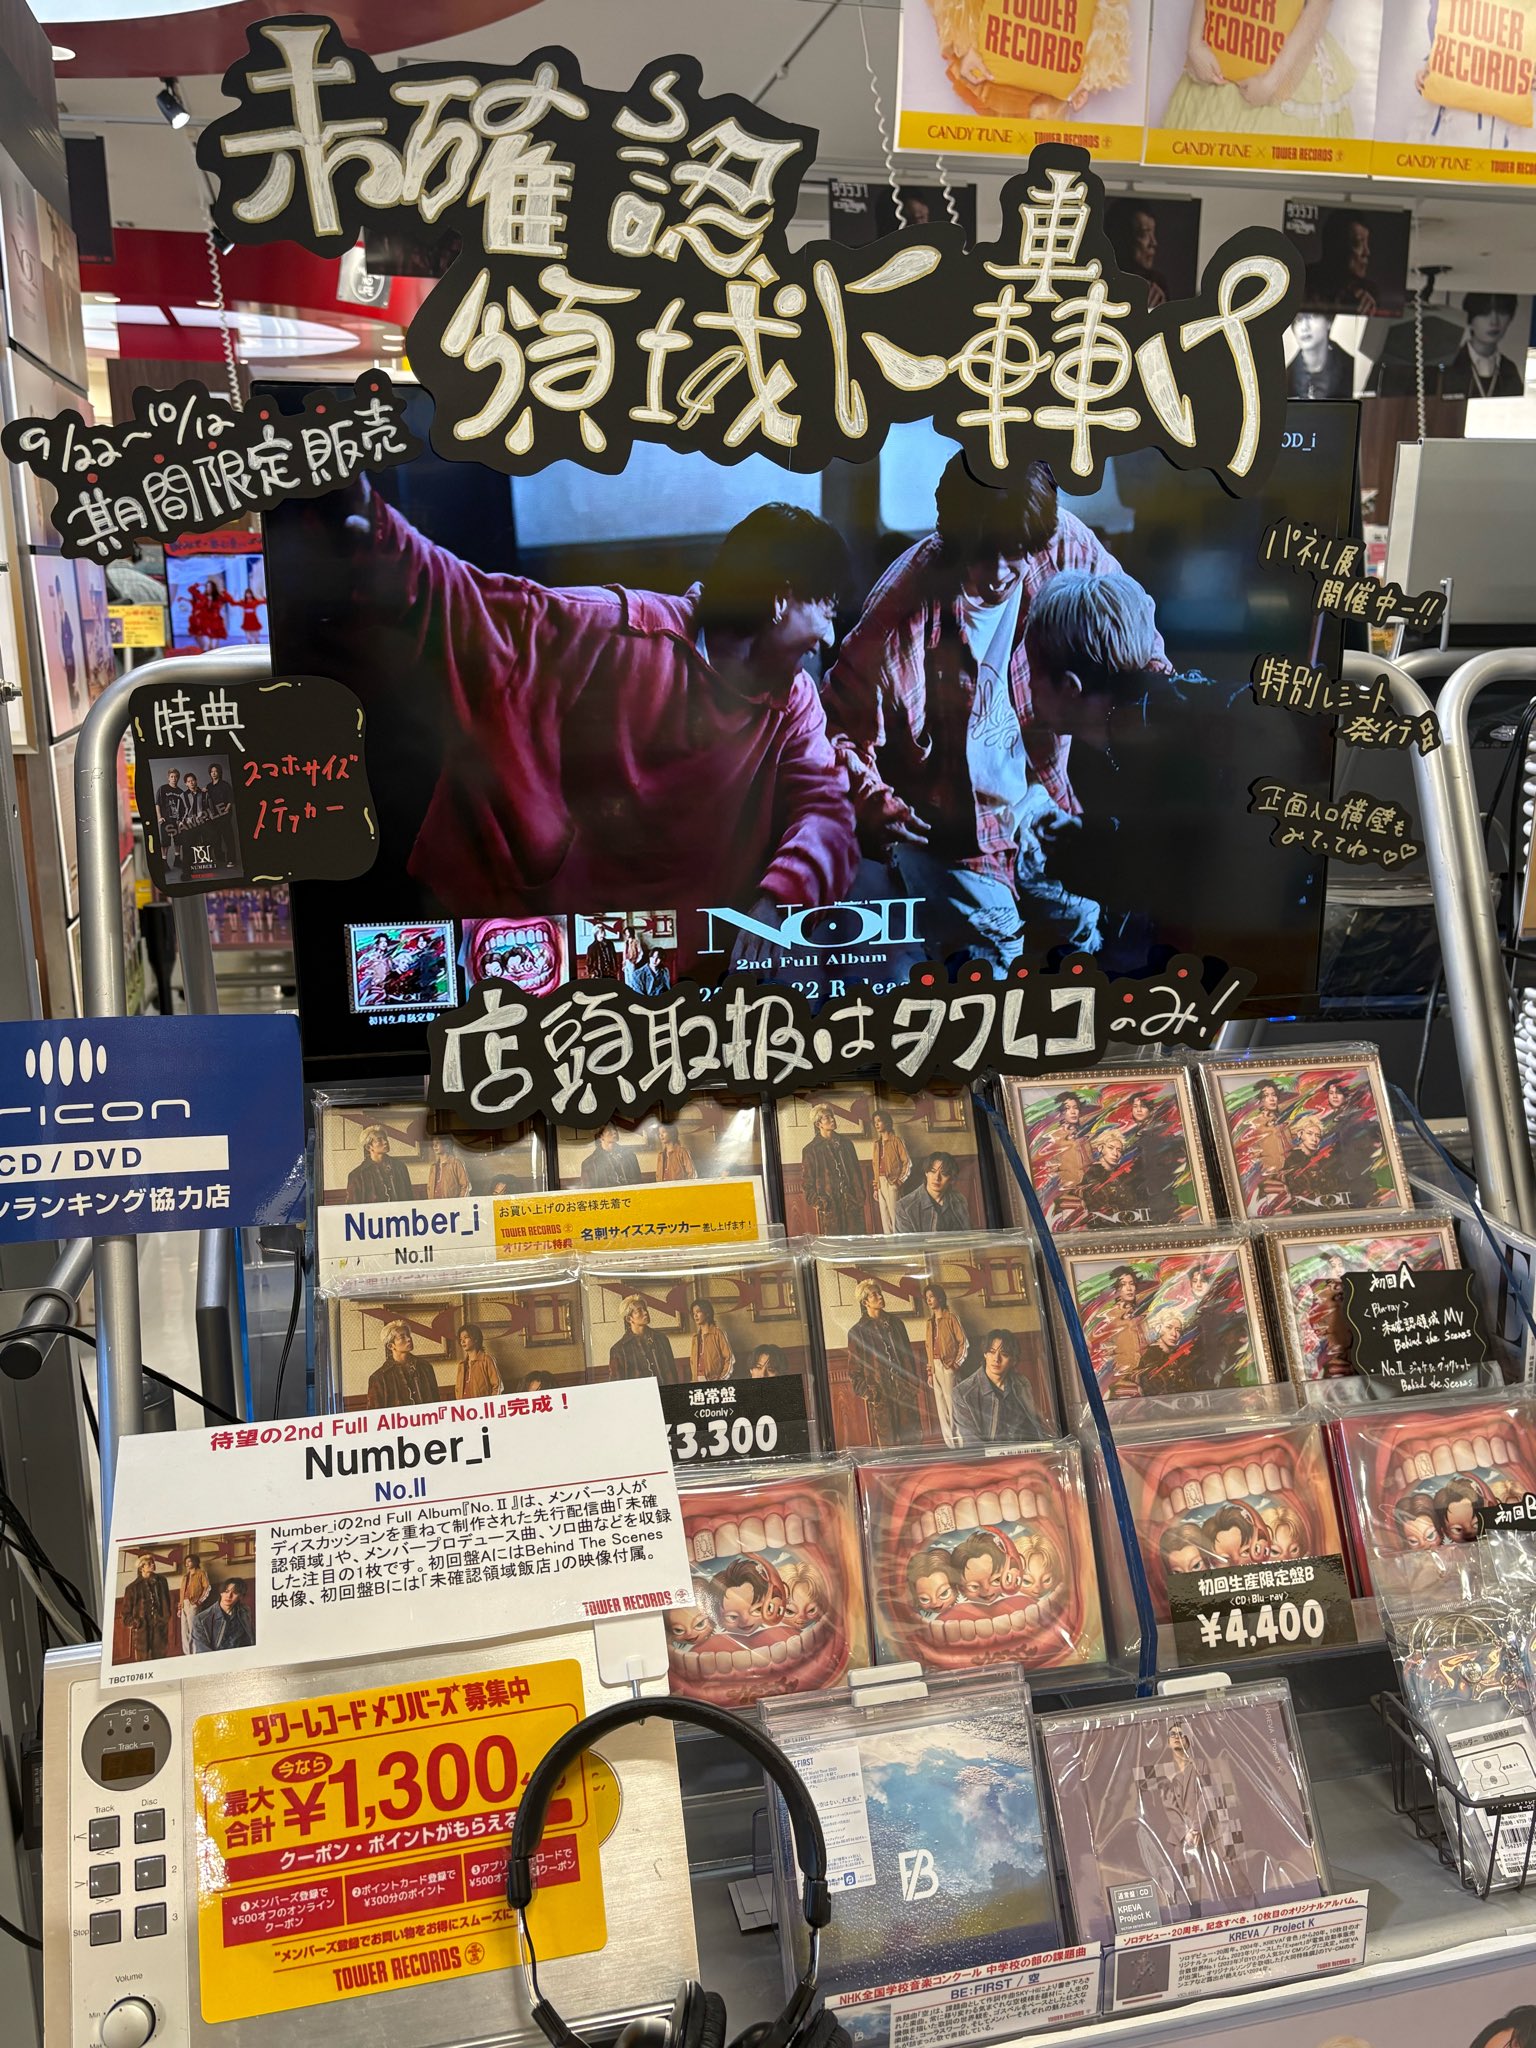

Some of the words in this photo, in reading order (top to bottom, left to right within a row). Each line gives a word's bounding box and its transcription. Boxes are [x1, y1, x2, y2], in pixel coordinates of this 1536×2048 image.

[985, 15, 1084, 74] RECORDS
[1432, 33, 1534, 96] RECORDS
[928, 125, 974, 141] CANDY
[977, 128, 1012, 143] TUNE
[220, 24, 803, 284] 未確認
[1172, 141, 1215, 157] CANDY
[1217, 144, 1251, 158] TUNE
[1272, 146, 1297, 160] TOWER
[1299, 148, 1333, 162] RECORDS
[1396, 154, 1438, 169] CANDY
[1440, 157, 1471, 171] TUNE
[1491, 159, 1515, 173] TOWER
[67, 398, 407, 556] 期間限定販売
[1266, 524, 1359, 577] パネル展
[153, 687, 245, 752] 特典
[243, 753, 358, 787] スマホサイズ
[165, 802, 229, 837] SAMPLE
[736, 957, 772, 970] 2nd
[779, 955, 818, 968] Full
[826, 953, 887, 965] Album
[344, 1204, 480, 1242] Number_i
[499, 1198, 631, 1218] お買い上げのお客様先着で
[501, 1227, 527, 1238] TOWER
[528, 1224, 562, 1236] RECORDS
[580, 1220, 701, 1241] 名刺サイズステッカー
[395, 1245, 433, 1265] No.II
[503, 1238, 573, 1253] オリジナル特典
[1444, 1307, 1463, 1327] MV
[1425, 1334, 1440, 1345] the
[689, 1386, 737, 1406] 通常盤
[210, 1425, 323, 1451] 待望の2nd
[332, 1416, 368, 1437] Full
[305, 1426, 491, 1480] Number_i
[375, 1477, 426, 1502] No.II
[271, 1514, 381, 1539] Number_iの2nd
[387, 1510, 412, 1525] Full
[271, 1494, 658, 1556] ディスカッションを重ねて制作された先行配信曲「未確
[271, 1508, 672, 1574] 認領域」や、メンバープロデュース曲、ソロ曲などを収録
[272, 1537, 574, 1591] した注目の1枚です。初回盤AにはBehind
[580, 1536, 606, 1549] The
[612, 1529, 663, 1545] Scenes
[271, 1545, 655, 1610] 映像、初回盤Bには「未確認領域飯店」の映像付属。
[1198, 1566, 1315, 1596] 初回生産限定盤B
[582, 1597, 621, 1616] TOWER
[624, 1590, 672, 1611] RECORDS
[1196, 1599, 1325, 1649] ¥4,400
[109, 1671, 154, 1685] TBCT0761X
[109, 1719, 113, 1727] 1
[126, 1717, 131, 1726] 2
[144, 1715, 149, 1723] 3
[121, 1707, 136, 1717] Disc
[118, 1741, 139, 1751] Track
[277, 1756, 326, 1777] 今なら
[282, 1734, 517, 1837] ¥1,300
[94, 1804, 115, 1814] Track
[141, 1798, 158, 1807] Disc
[224, 1786, 275, 1819] 最大
[225, 1817, 275, 1849] 合計
[172, 1865, 177, 1874] 2
[364, 1884, 445, 1909] ¥300分のポイント
[1117, 1903, 1142, 1914] KREVA
[172, 1913, 178, 1921] 3
[265, 1916, 303, 1934] クーポン
[1119, 1912, 1144, 1923] Project
[1145, 1911, 1151, 1919] K
[73, 1928, 90, 1939] Stop
[1229, 1928, 1259, 1942] KREVA
[1272, 1921, 1305, 1934] Project
[1308, 1918, 1315, 1928] K
[115, 1972, 143, 1982] Volume
[333, 1957, 389, 1991] TOWER
[394, 1946, 462, 1980] RECORDS
[839, 1968, 982, 2005] NHK全国学校音楽コンクール
[987, 1947, 1087, 1975] 中学校の部の課題曲
[950, 1978, 1012, 2000] BE:FIRST
[1028, 1973, 1039, 1985] 空
